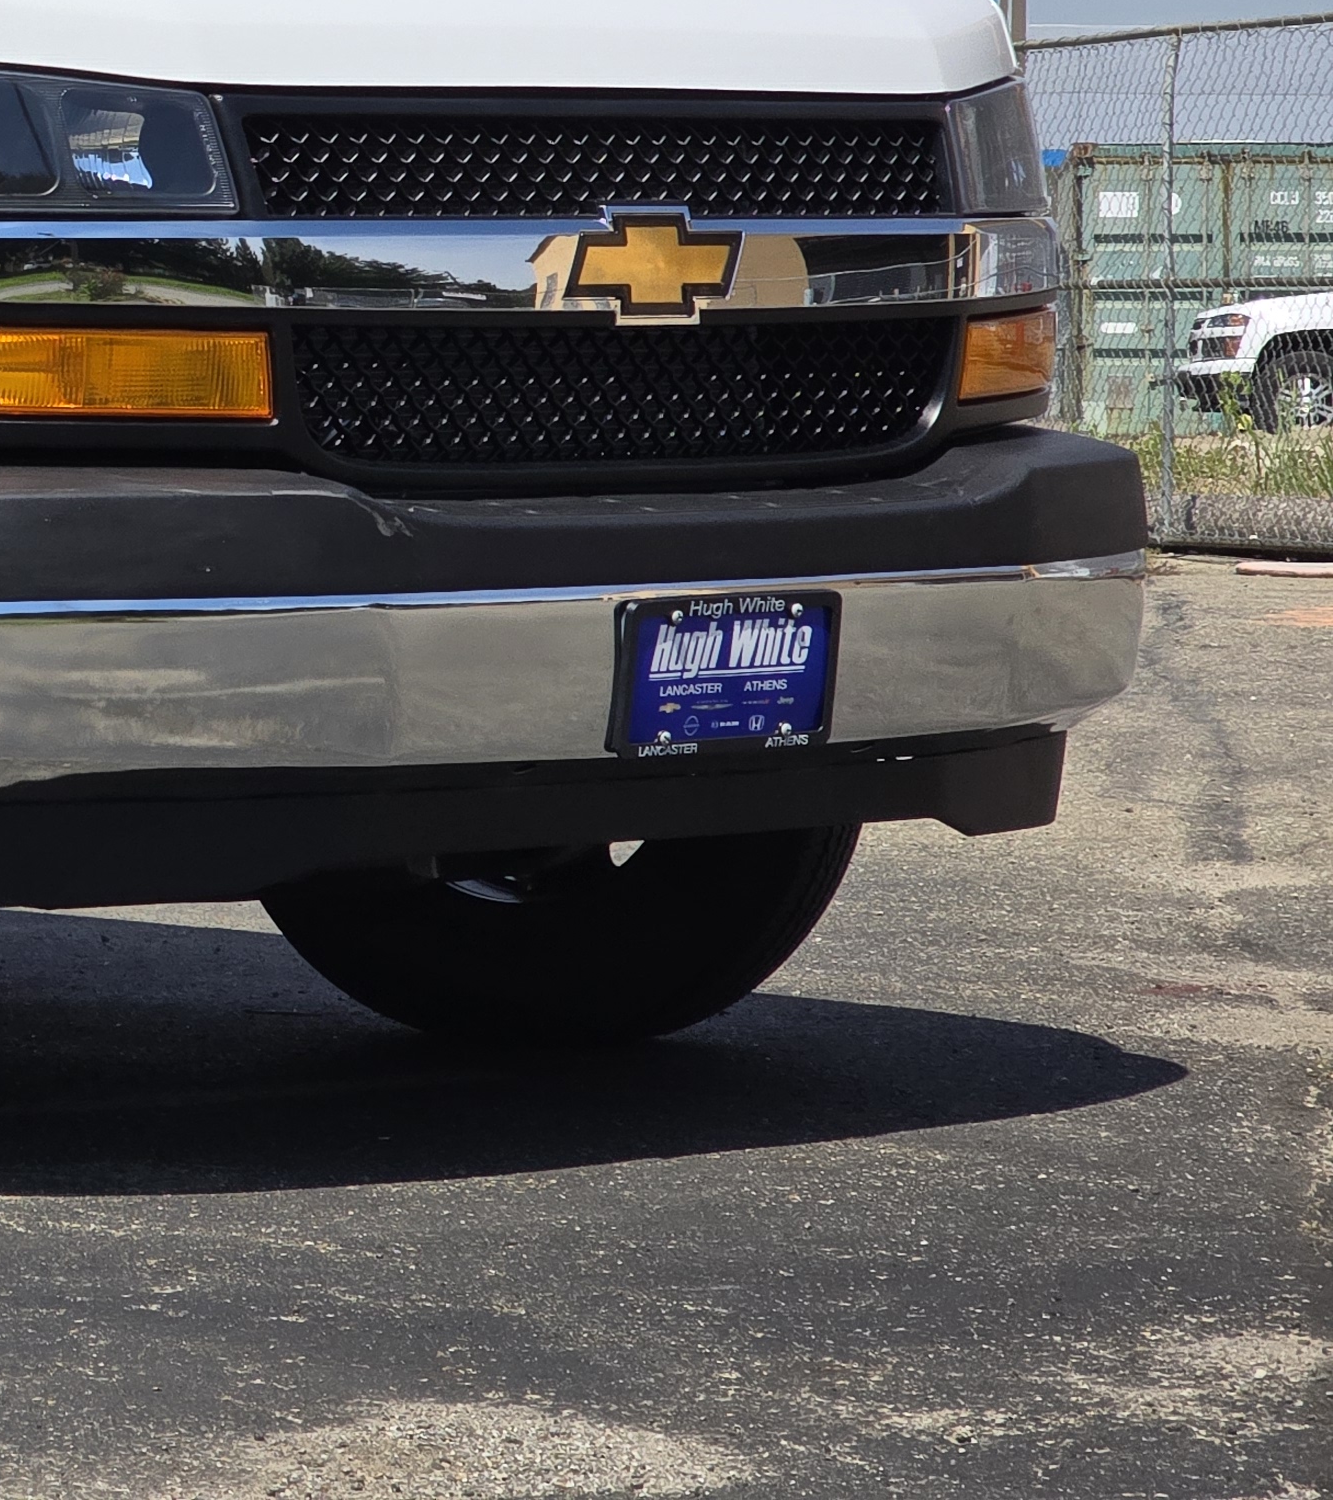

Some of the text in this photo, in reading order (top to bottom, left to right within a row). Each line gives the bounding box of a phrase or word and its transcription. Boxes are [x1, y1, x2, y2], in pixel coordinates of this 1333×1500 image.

[689, 596, 785, 618] Hugh White
[650, 618, 813, 679] Hugh White
[659, 679, 788, 697] LANCASTER ATHENS
[638, 734, 809, 758] LANCASTER ATHENS
